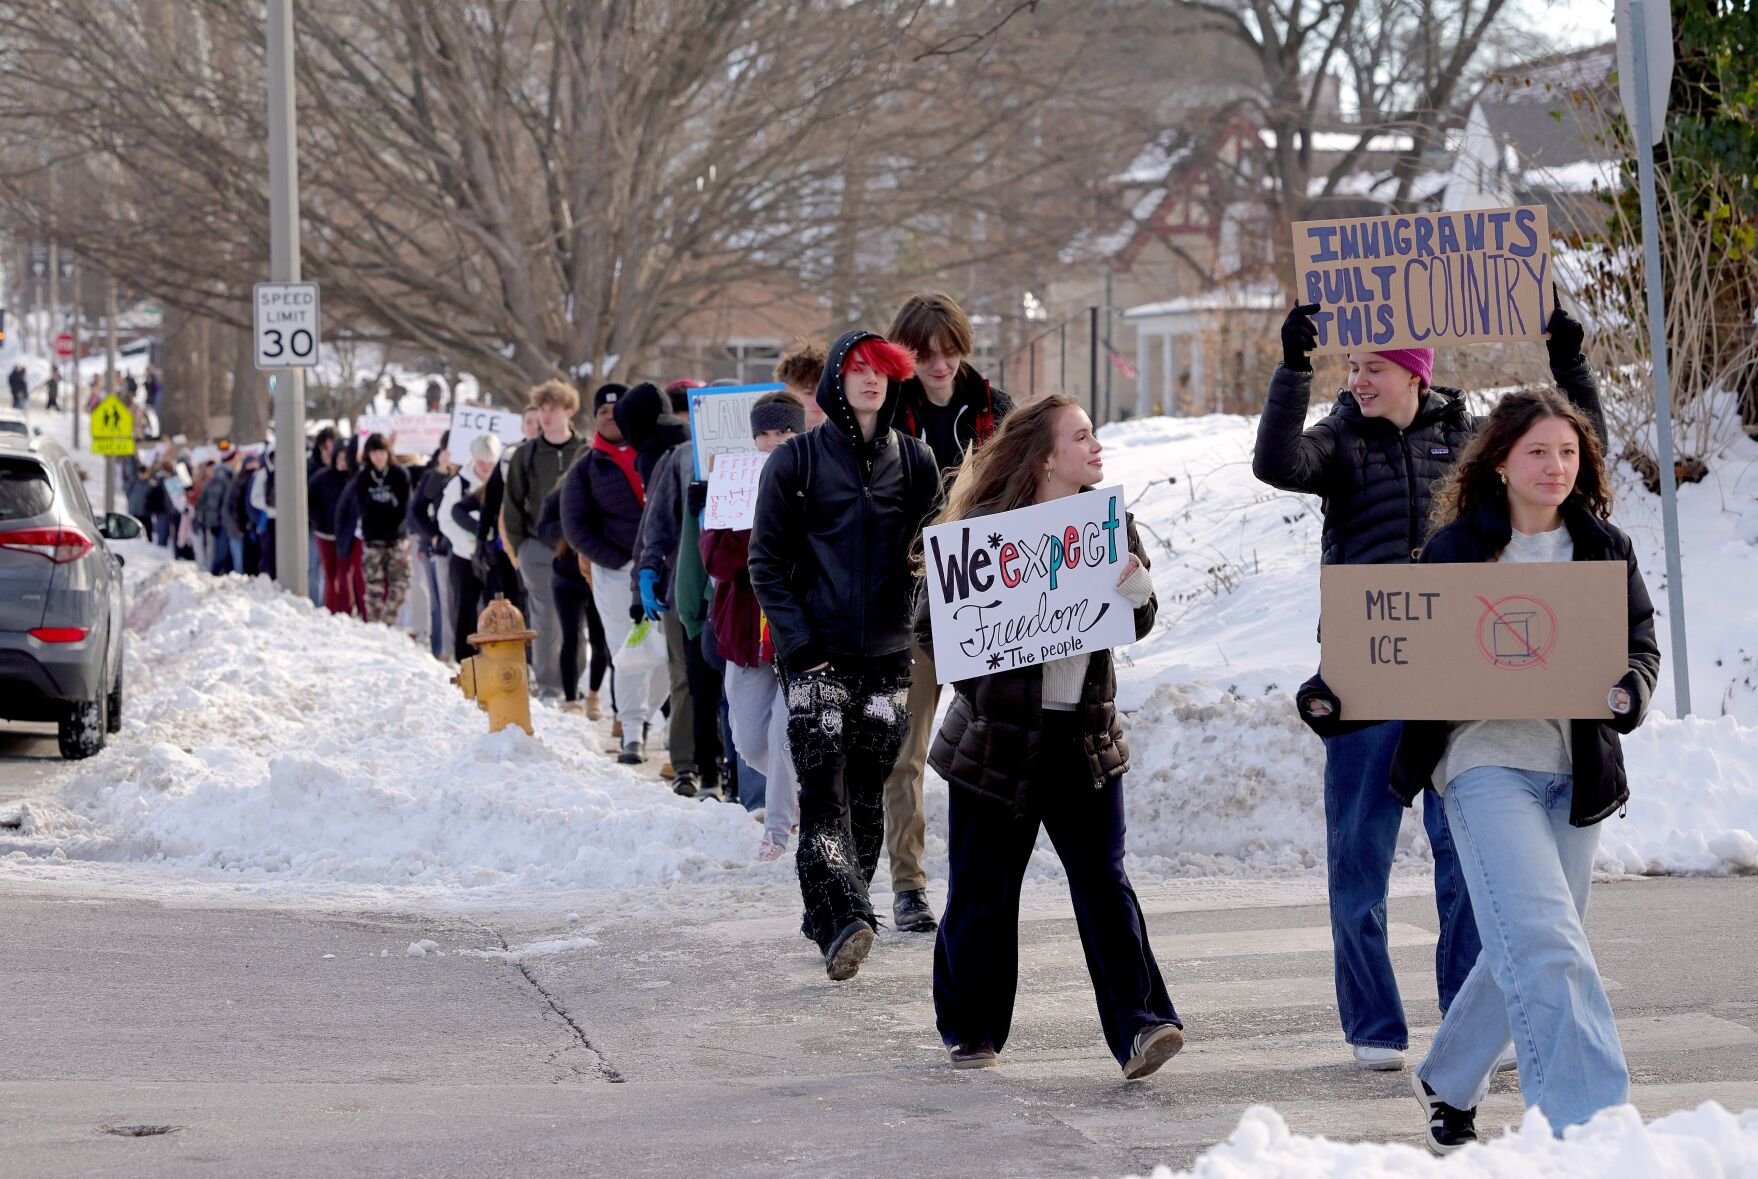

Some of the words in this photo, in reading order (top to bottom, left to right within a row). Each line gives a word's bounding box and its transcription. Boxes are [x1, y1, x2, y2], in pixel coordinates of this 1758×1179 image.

[1307, 208, 1538, 263] IMMIGRANTS
[261, 292, 313, 306] SPEED
[1305, 265, 1397, 305] BUILT
[1404, 252, 1548, 341] COUNTRY
[266, 310, 307, 323] LIMIT
[1311, 304, 1395, 347] THIS
[263, 329, 313, 358] 30
[459, 412, 502, 433] ICE
[701, 396, 758, 441] LAN
[999, 496, 1120, 590] expect
[1365, 590, 1440, 621] MELT
[952, 592, 1110, 658] Freedom
[1041, 636, 1084, 661] people
[1369, 635, 1409, 665] ICE
